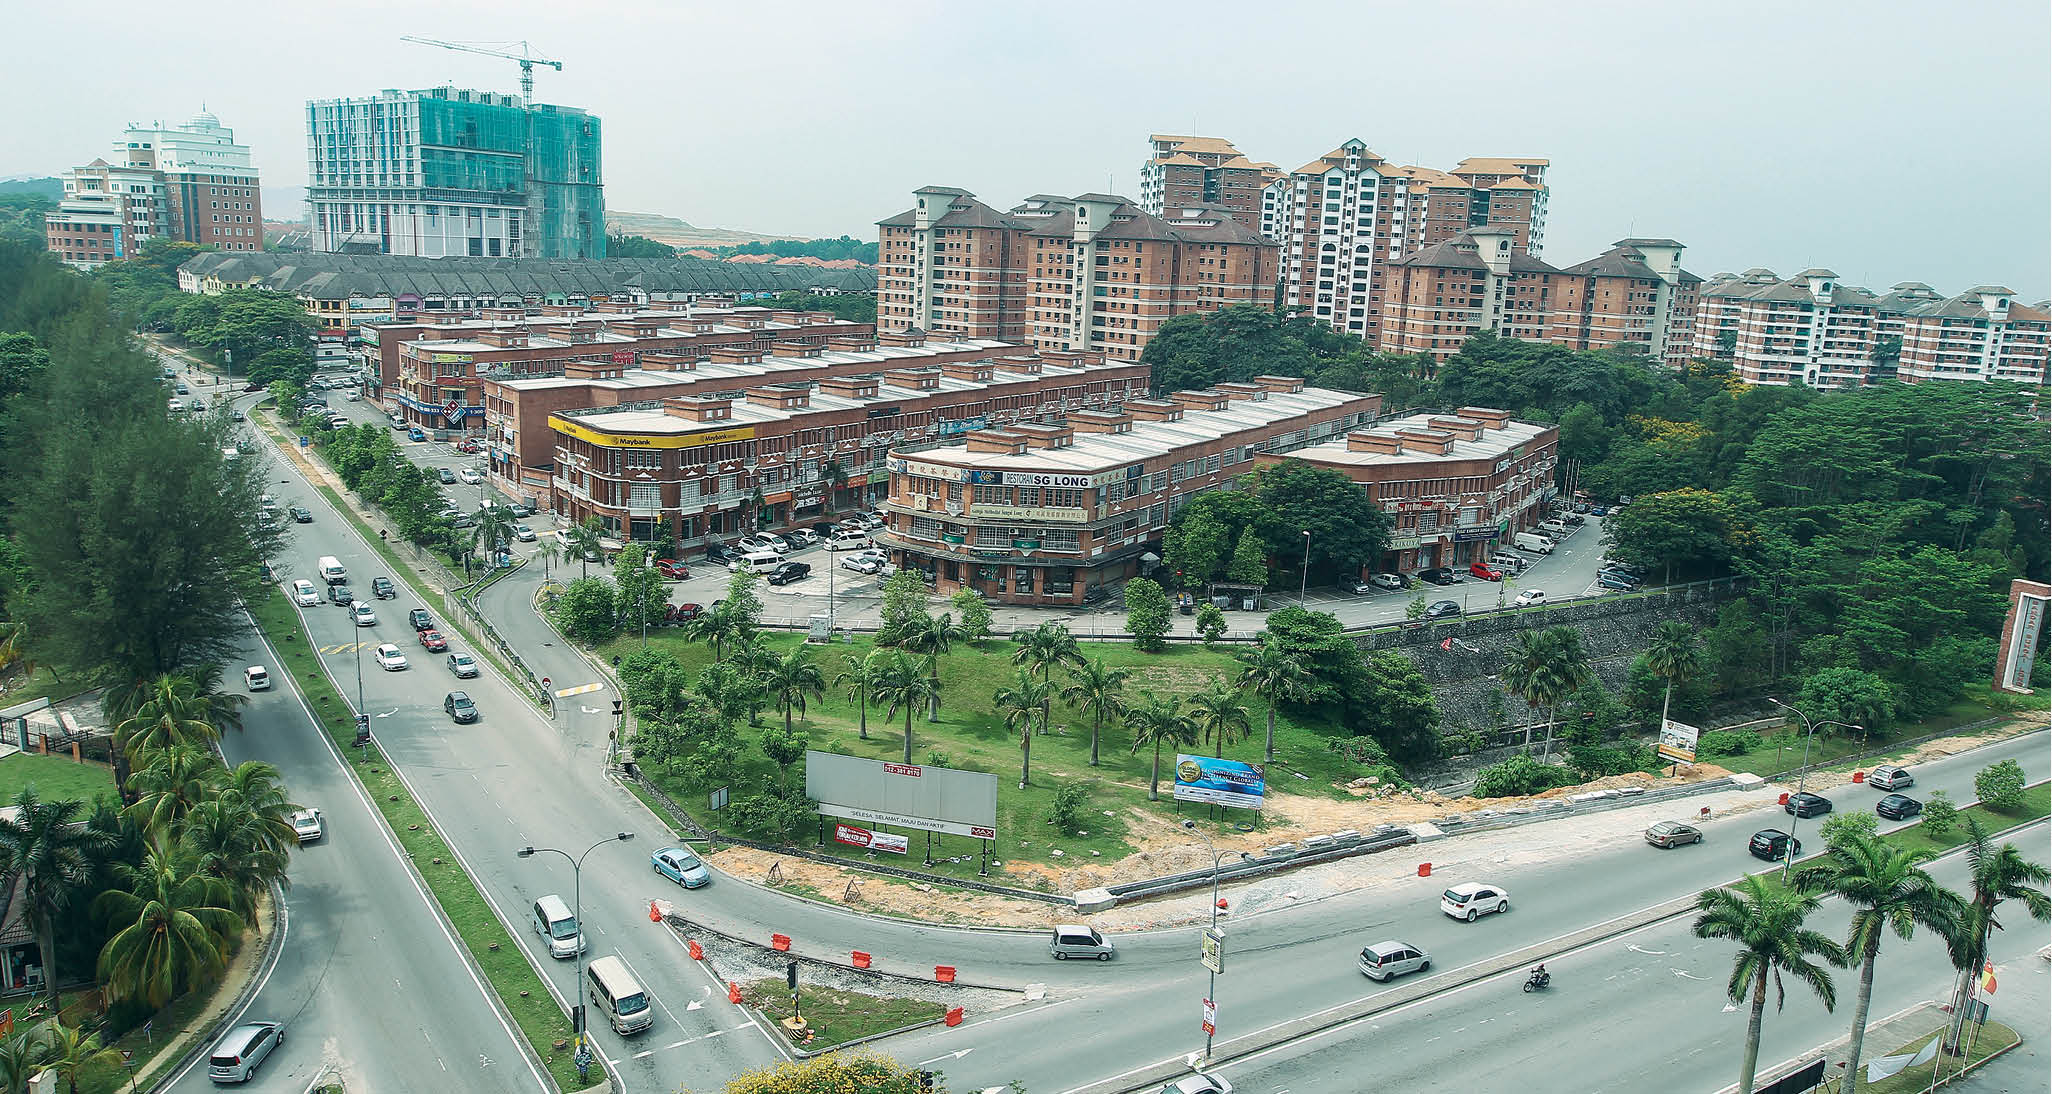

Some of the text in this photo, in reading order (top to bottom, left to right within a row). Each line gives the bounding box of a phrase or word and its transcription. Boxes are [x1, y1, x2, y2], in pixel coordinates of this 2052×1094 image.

[704, 433, 728, 442] Maybank
[619, 438, 651, 447] Maybank
[1033, 475, 1050, 486] SG
[1054, 476, 1089, 487] LONG
[2027, 600, 2039, 630] BANDAR
[900, 818, 917, 826] MAJU
[916, 820, 928, 828] DAN
[972, 828, 994, 836] MAX
